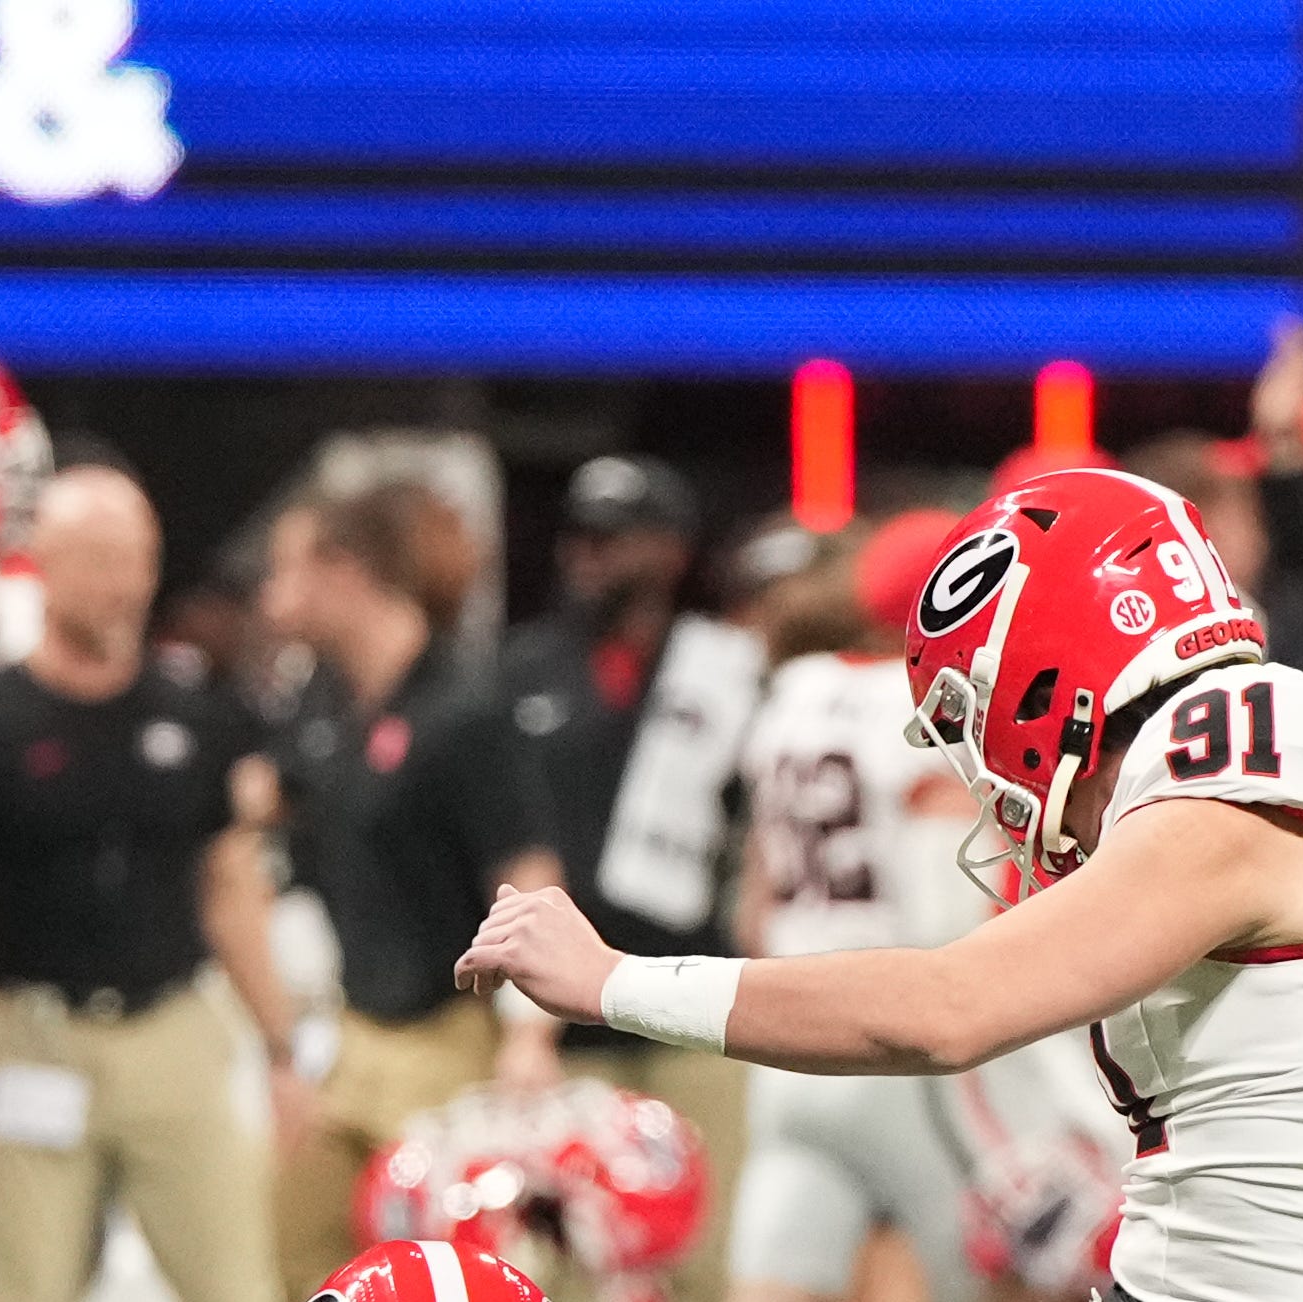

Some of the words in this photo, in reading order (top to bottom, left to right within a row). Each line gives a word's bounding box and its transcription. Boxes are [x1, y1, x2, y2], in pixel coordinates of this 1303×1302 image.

[918, 529, 1019, 637] G
[1116, 594, 1151, 628] SEC
[1165, 681, 1281, 782] 91
